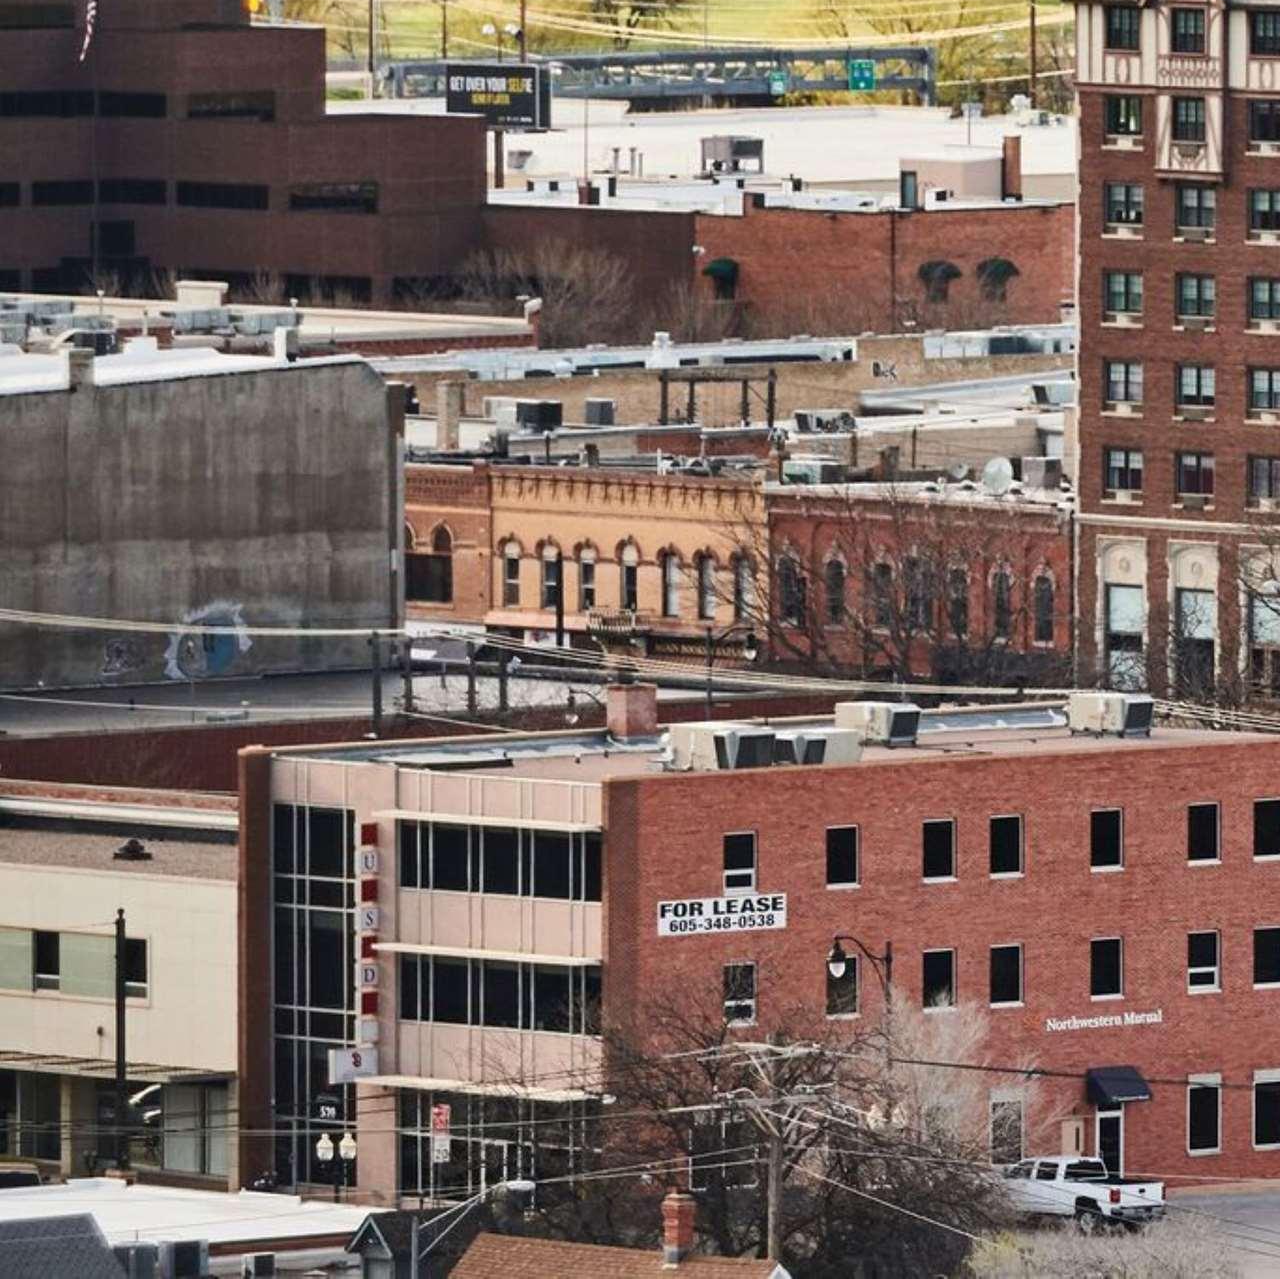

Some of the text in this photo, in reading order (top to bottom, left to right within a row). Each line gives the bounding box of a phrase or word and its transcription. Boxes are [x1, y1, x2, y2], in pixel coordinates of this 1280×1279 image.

[449, 76, 464, 92] GET
[660, 896, 784, 919] FOR LEASE
[669, 914, 775, 932] 605-348-0538
[1046, 1008, 1162, 1032] Northwestern Mutual
